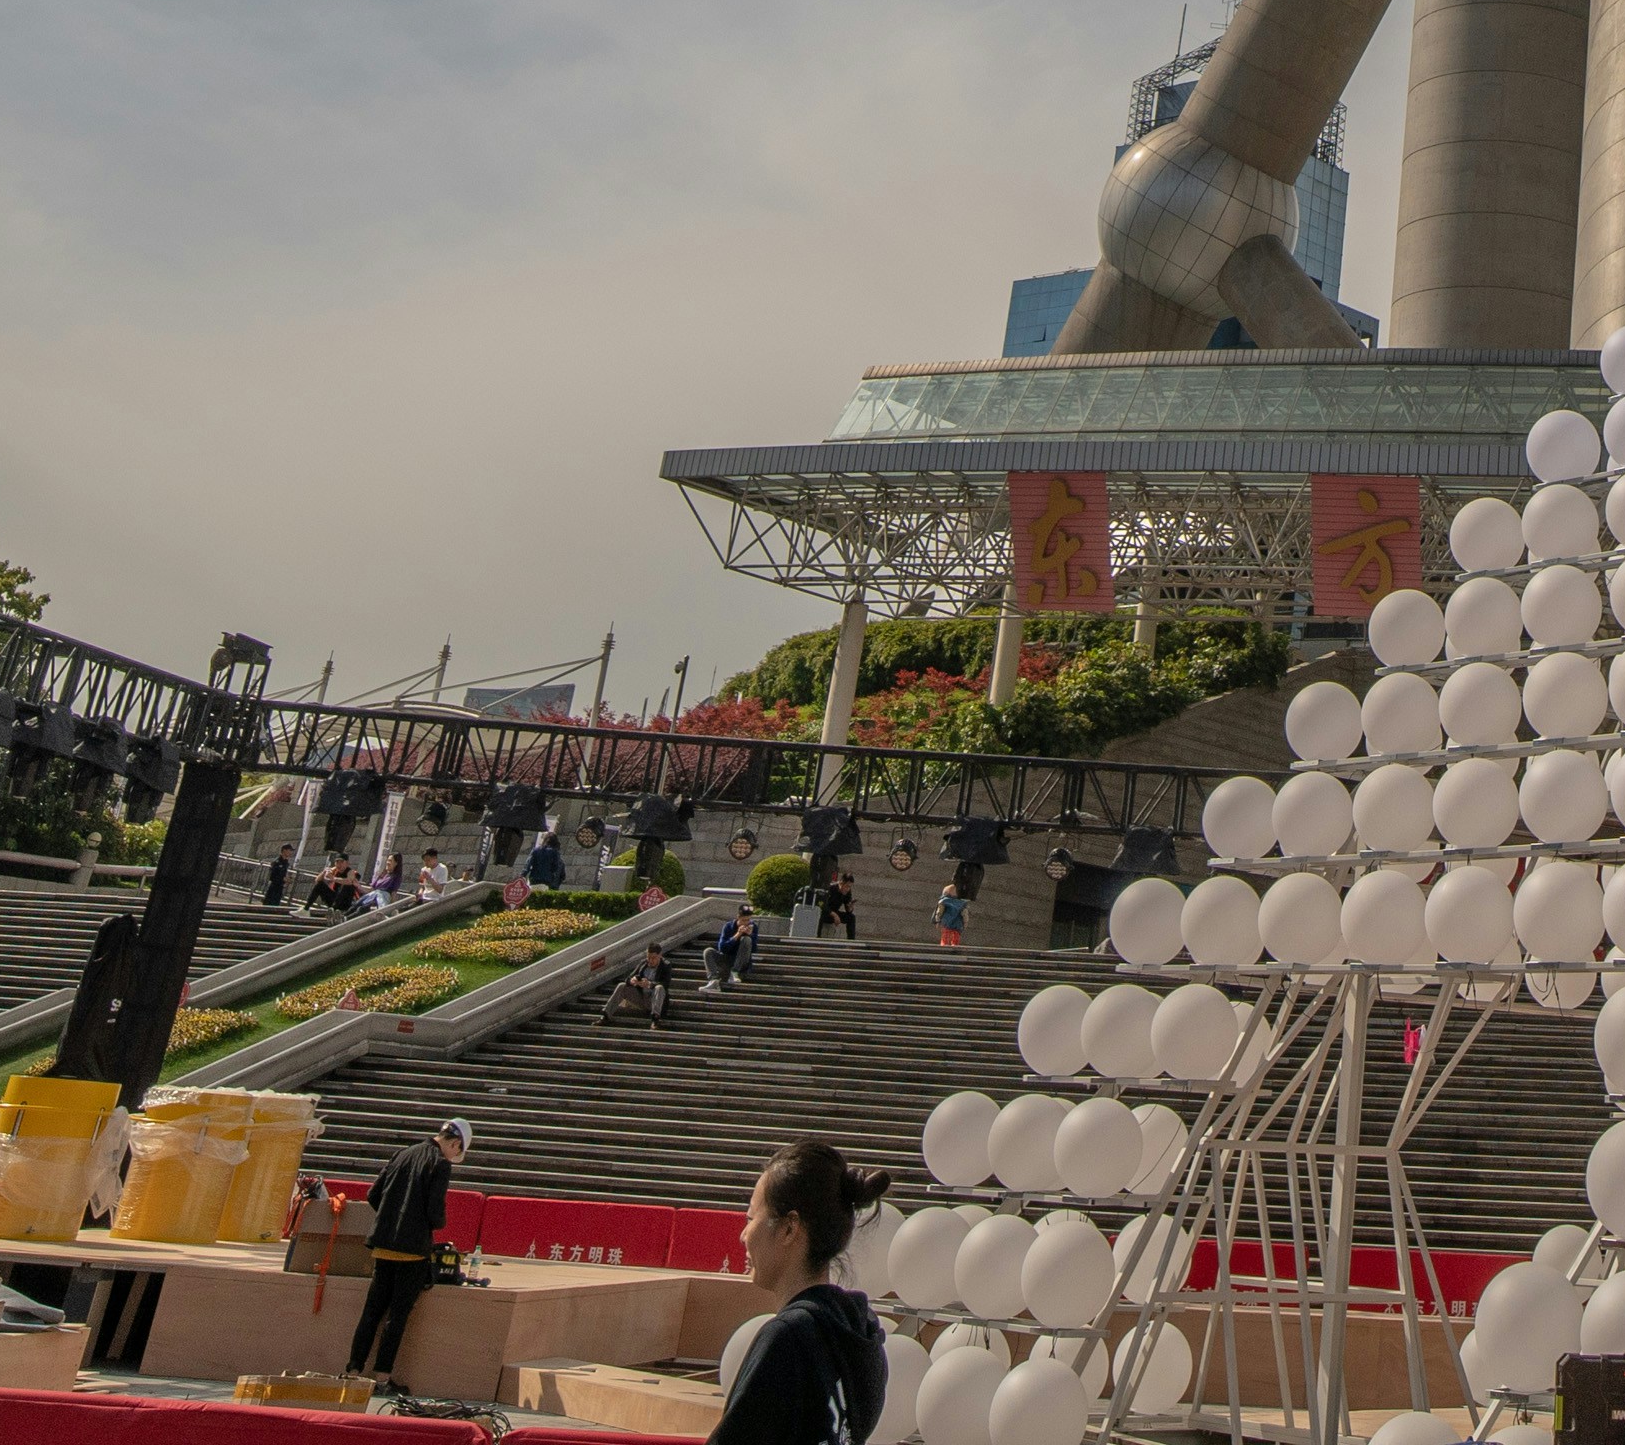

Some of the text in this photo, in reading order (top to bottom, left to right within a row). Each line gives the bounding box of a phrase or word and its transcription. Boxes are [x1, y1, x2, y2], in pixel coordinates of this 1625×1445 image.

[1028, 477, 1411, 605] 东 方
[548, 1243, 624, 1265] 东方明珠
